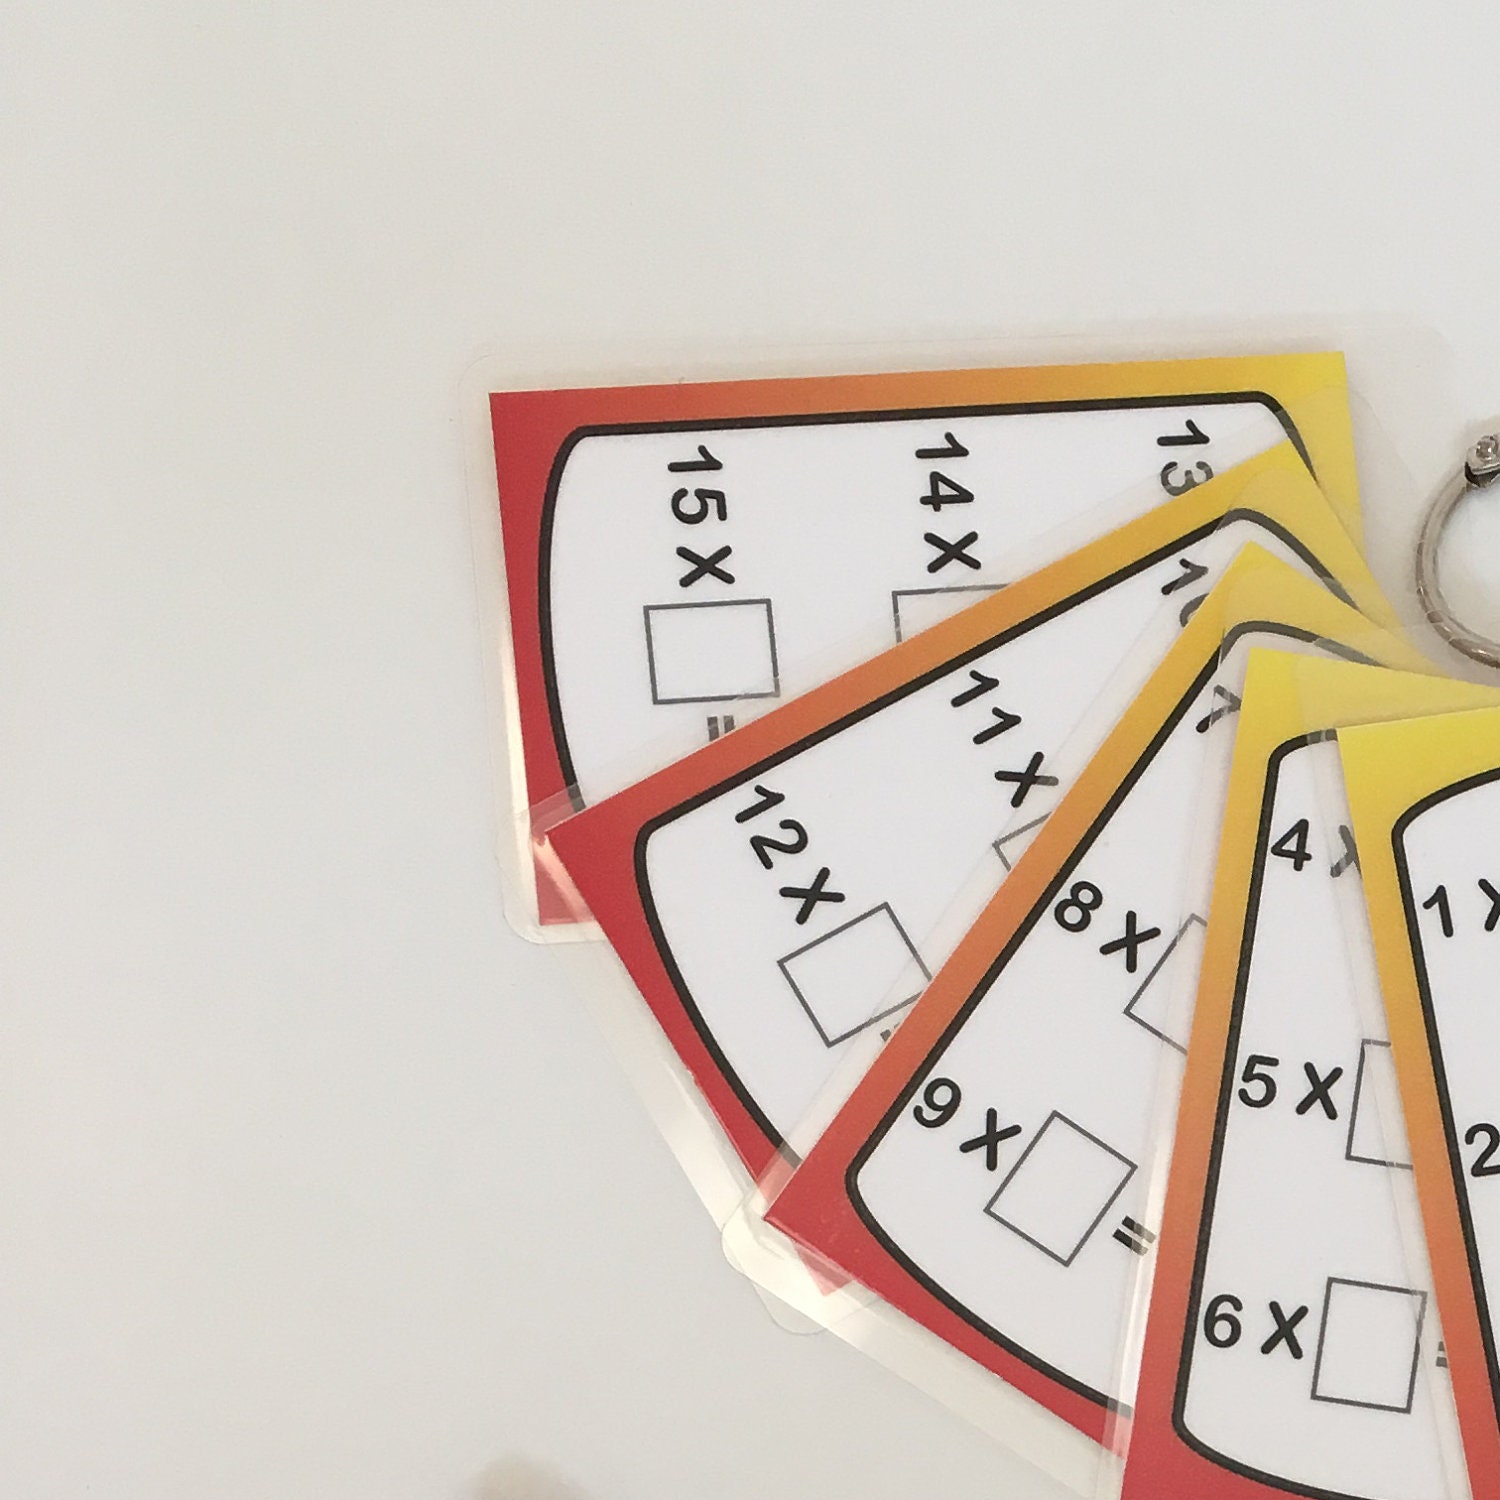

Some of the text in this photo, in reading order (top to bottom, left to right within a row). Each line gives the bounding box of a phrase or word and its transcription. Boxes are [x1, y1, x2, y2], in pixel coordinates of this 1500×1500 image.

[668, 446, 726, 524] 15
[916, 433, 974, 511] 14
[1157, 420, 1213, 496] 13
[952, 671, 1021, 744] 11
[735, 786, 807, 869] 12
[1271, 818, 1312, 872] 4
[1055, 881, 1103, 932] 8
[1423, 885, 1453, 938] 1
[914, 1078, 962, 1128] 9
[1238, 1055, 1279, 1108] 5
[1204, 1295, 1243, 1348] 6
